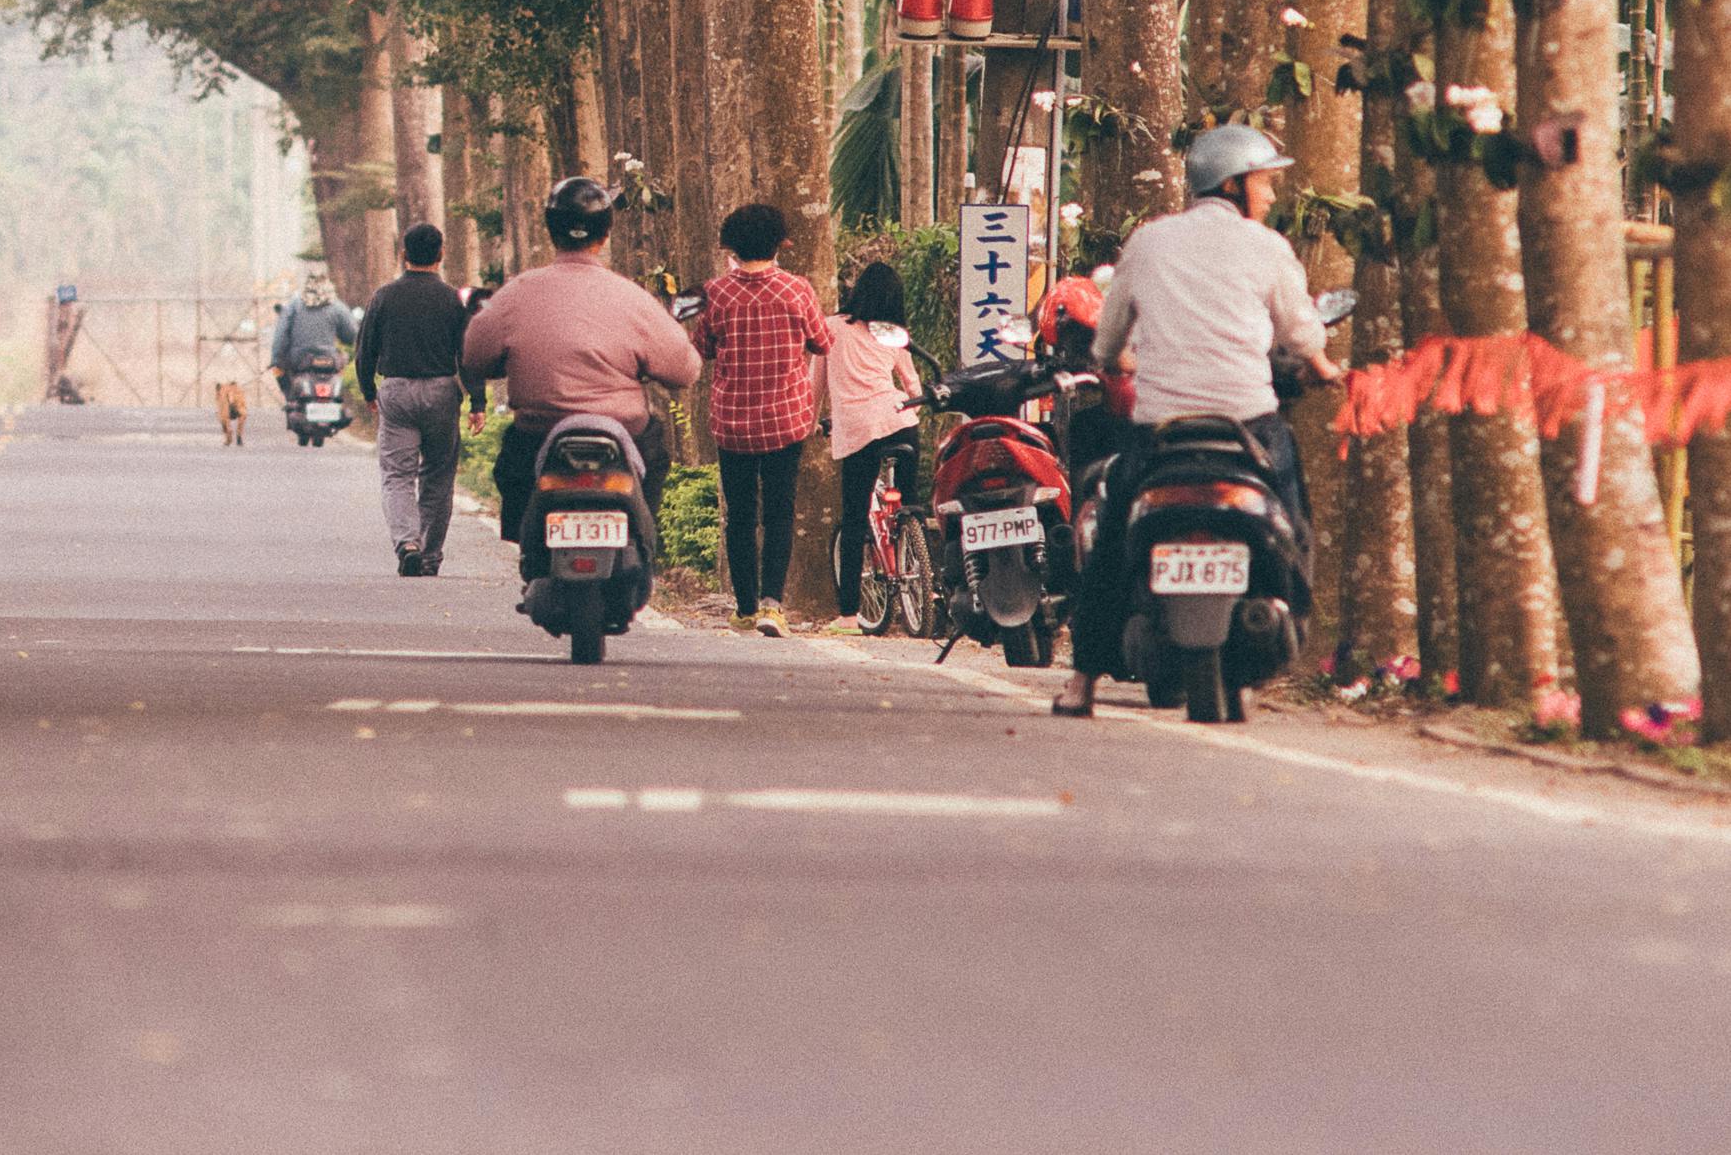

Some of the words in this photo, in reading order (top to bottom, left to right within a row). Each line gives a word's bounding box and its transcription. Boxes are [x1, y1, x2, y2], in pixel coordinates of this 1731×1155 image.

[972, 212, 1016, 362] 三十六天
[967, 519, 1035, 543] 977-PMP
